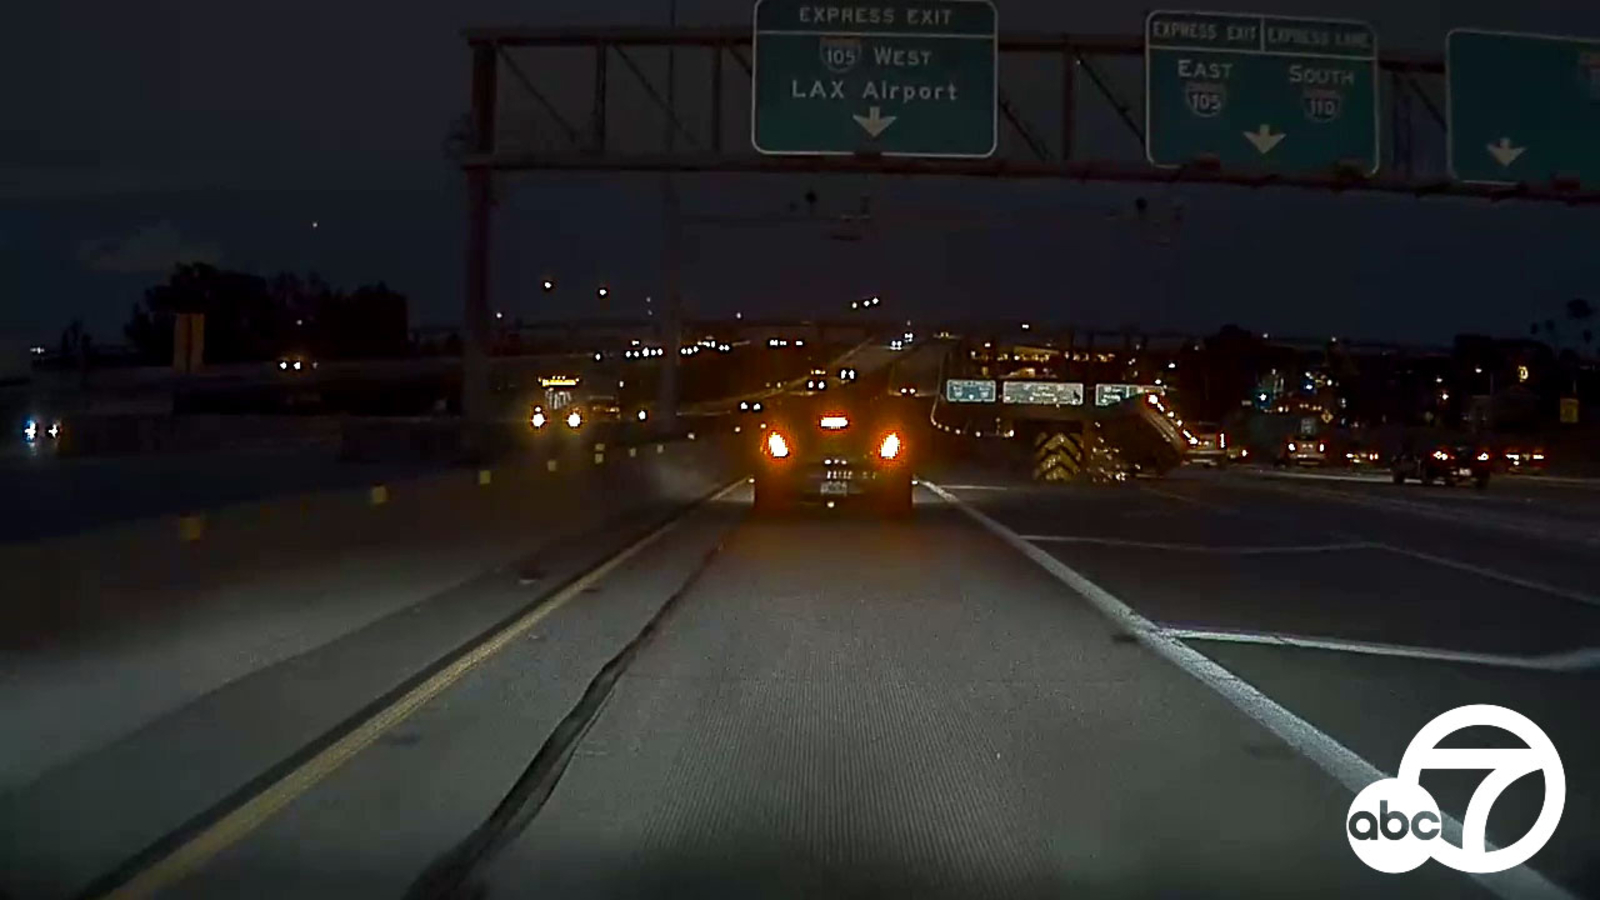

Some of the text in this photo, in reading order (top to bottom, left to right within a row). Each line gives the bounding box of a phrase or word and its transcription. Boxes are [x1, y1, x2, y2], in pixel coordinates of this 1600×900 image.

[799, 7, 952, 25] EXPRESS EXIT
[1152, 21, 1257, 42] EXPRESS EXIT
[1267, 27, 1372, 49] EXPRESS LANE
[826, 46, 933, 66] 105 WEST
[1177, 59, 1234, 79] EAST
[1289, 64, 1355, 86] SOUTH
[791, 80, 958, 103] LAX Airport
[1191, 91, 1222, 112] 105
[1308, 97, 1336, 115] 110
